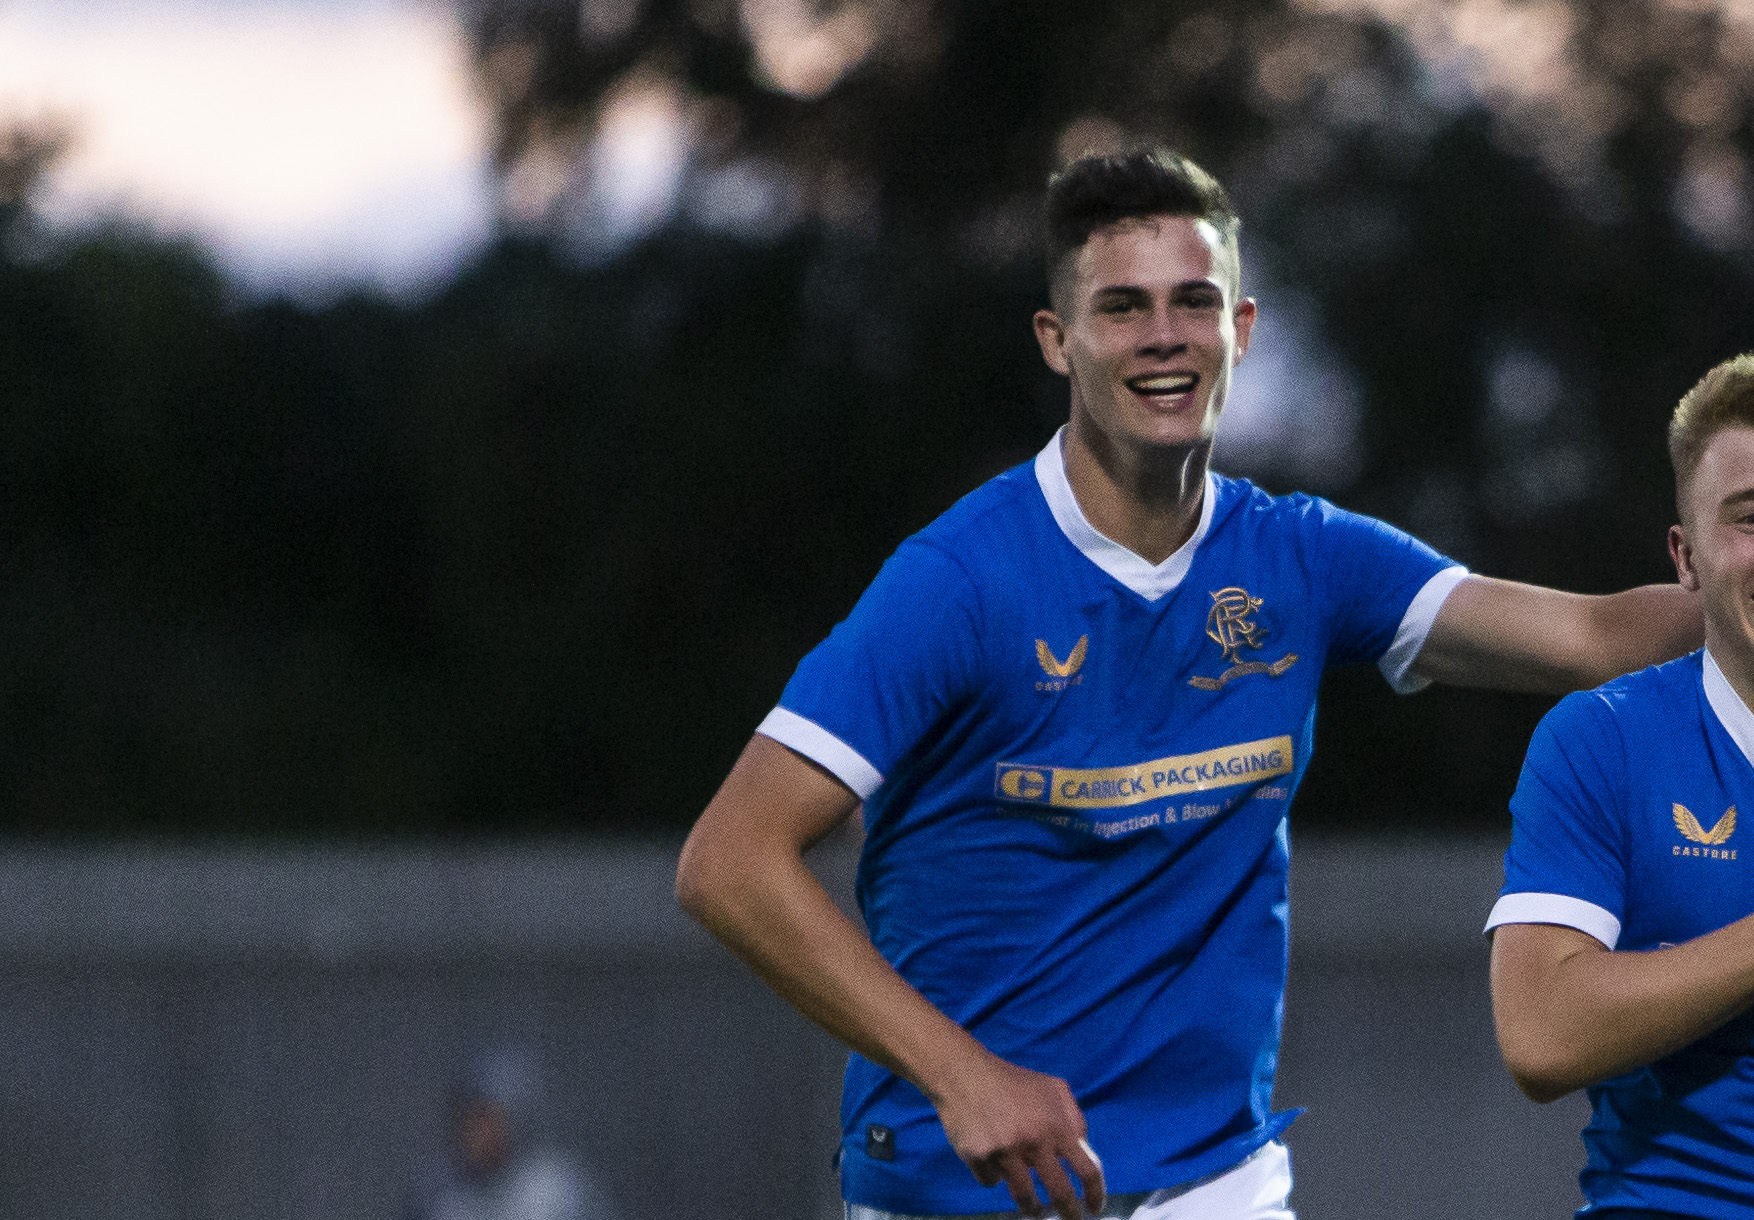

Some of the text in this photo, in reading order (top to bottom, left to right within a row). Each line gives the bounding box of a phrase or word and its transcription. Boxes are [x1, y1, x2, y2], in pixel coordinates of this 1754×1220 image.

[1061, 750, 1283, 800] CARRICK PACKAGING
[1093, 813, 1160, 839] Injection
[1164, 806, 1178, 824] &
[1181, 803, 1221, 821] Blow
[1672, 845, 1738, 861] CASTORE
